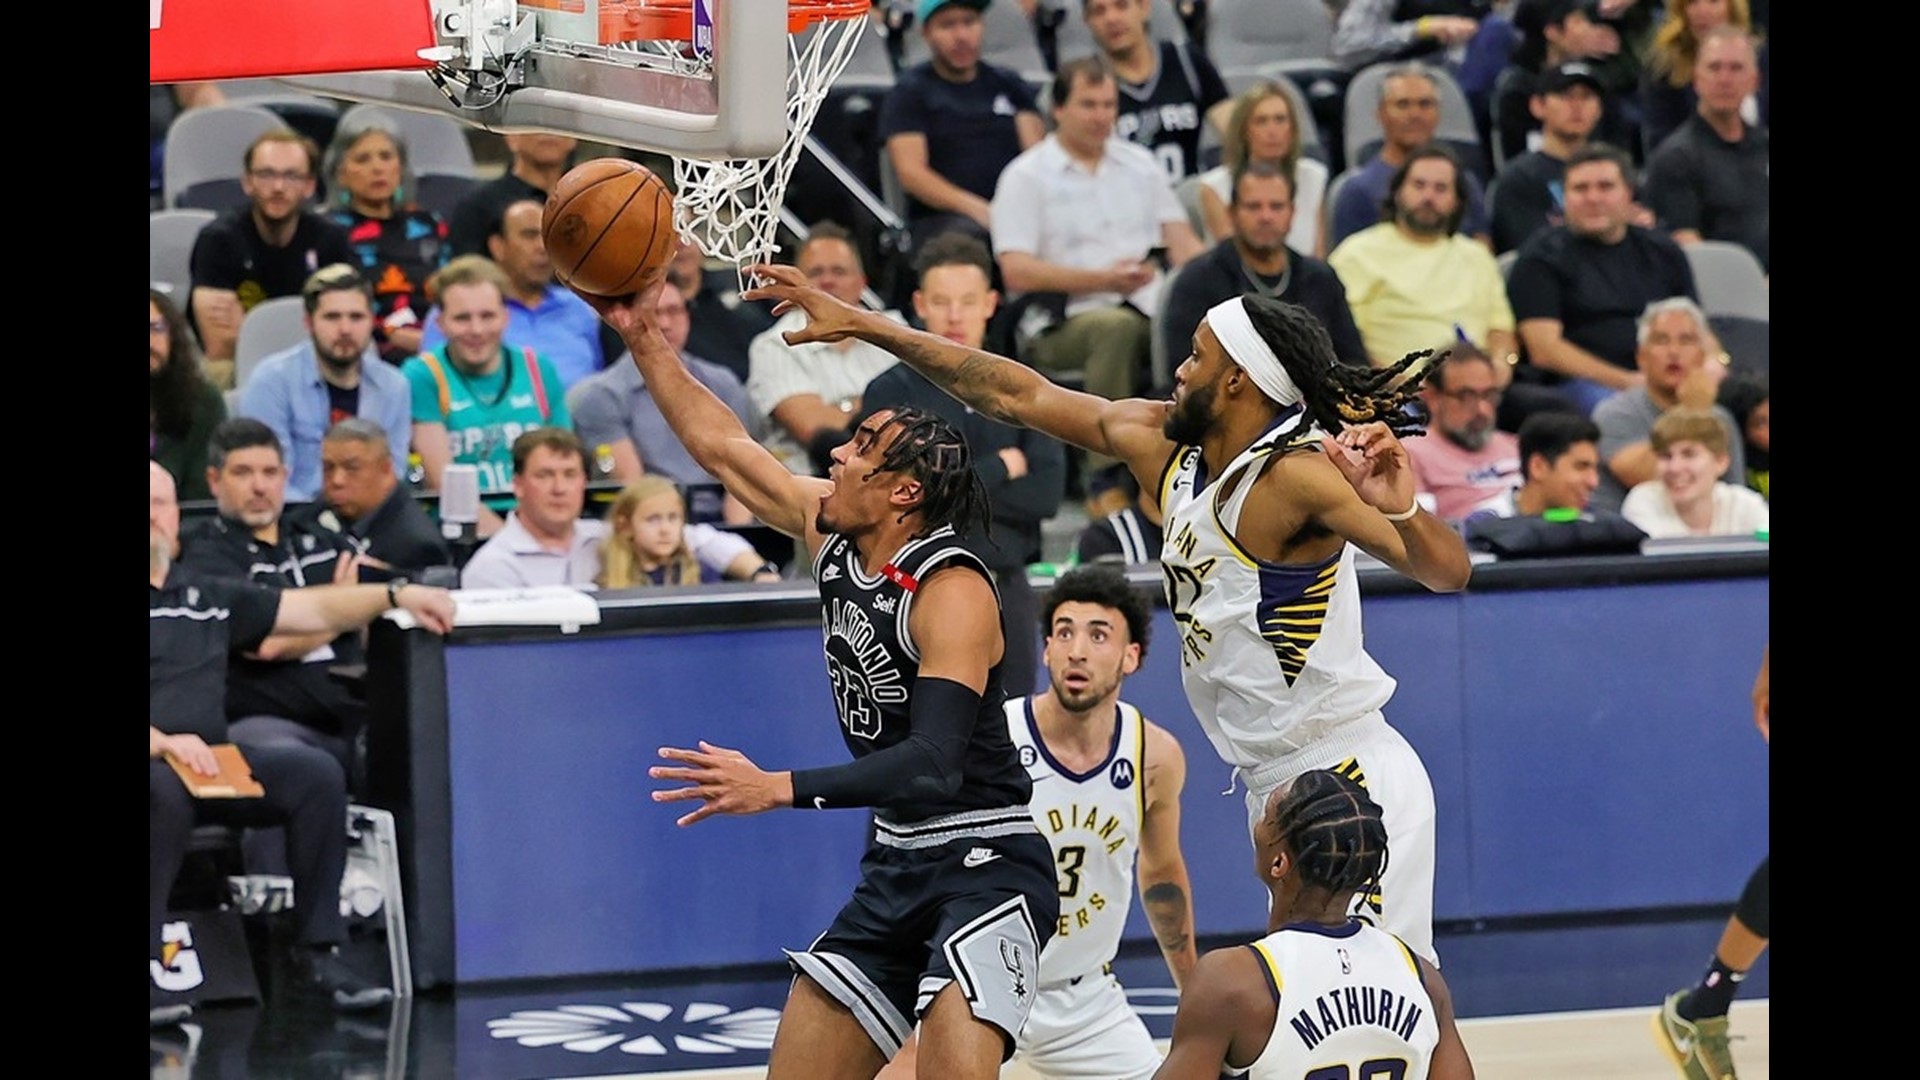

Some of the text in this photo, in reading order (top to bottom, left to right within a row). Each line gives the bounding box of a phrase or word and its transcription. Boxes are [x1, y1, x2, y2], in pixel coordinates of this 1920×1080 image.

[1182, 451, 1199, 469] 6
[833, 539, 848, 557] 6
[1166, 517, 1216, 578] IANA
[1019, 747, 1034, 767] 6
[1047, 804, 1126, 854] DIANA
[1057, 845, 1086, 898] 3
[1058, 892, 1107, 937] ERS
[1289, 986, 1423, 1052] MATHURIN
